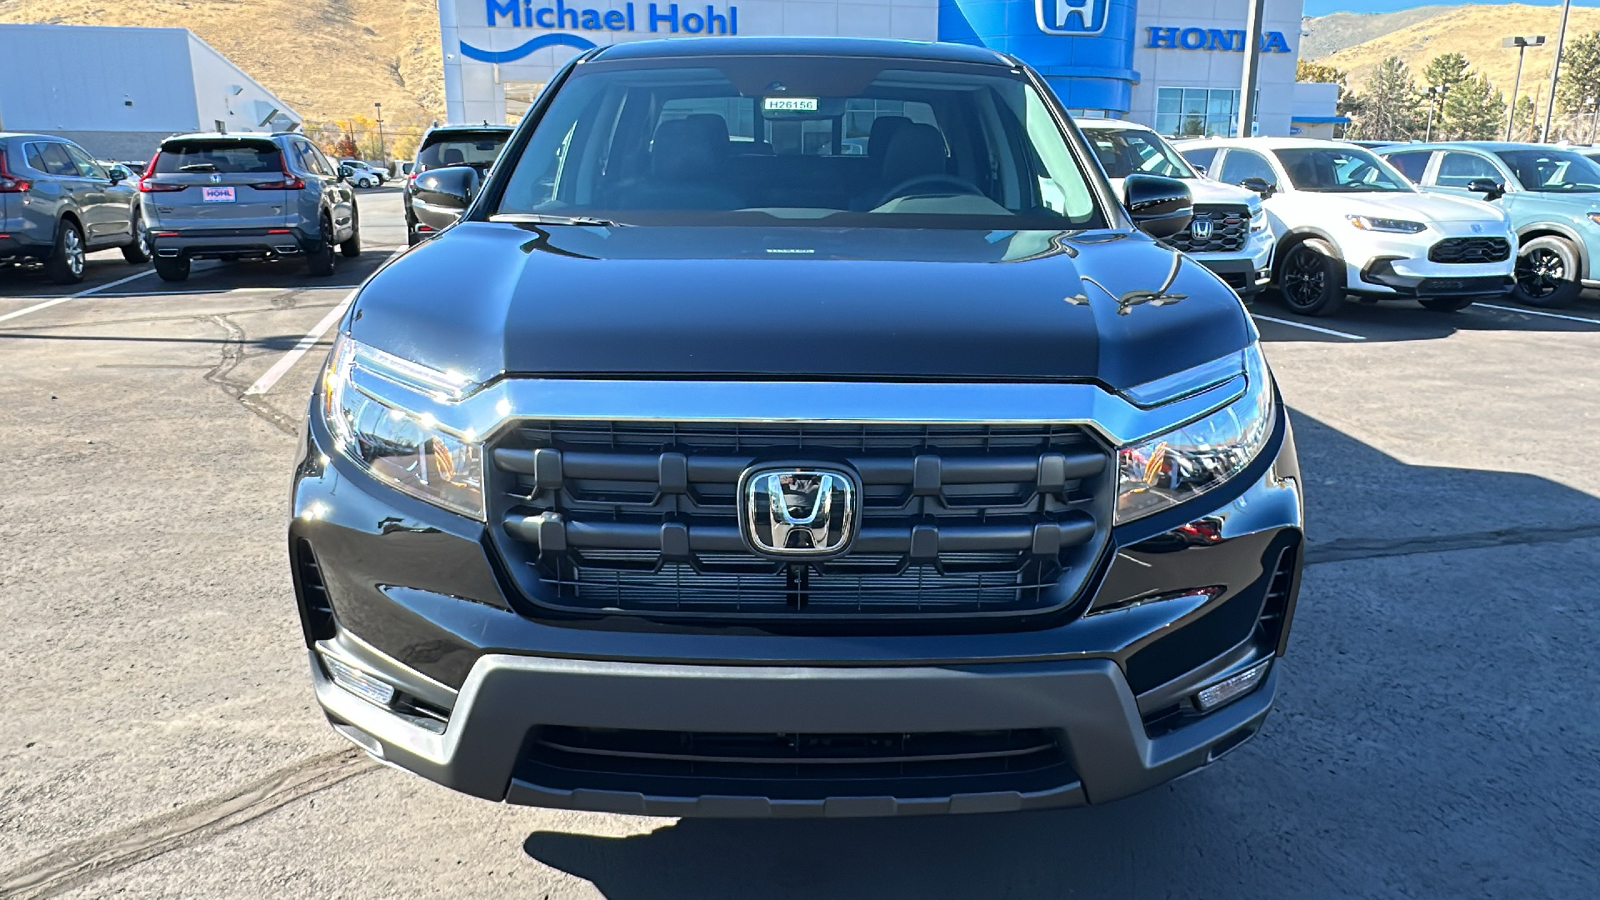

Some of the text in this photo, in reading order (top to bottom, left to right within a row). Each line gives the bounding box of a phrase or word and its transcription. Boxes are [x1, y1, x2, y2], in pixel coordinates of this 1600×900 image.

[486, 0, 737, 36] Michael Hohl
[769, 101, 813, 109] H26156
